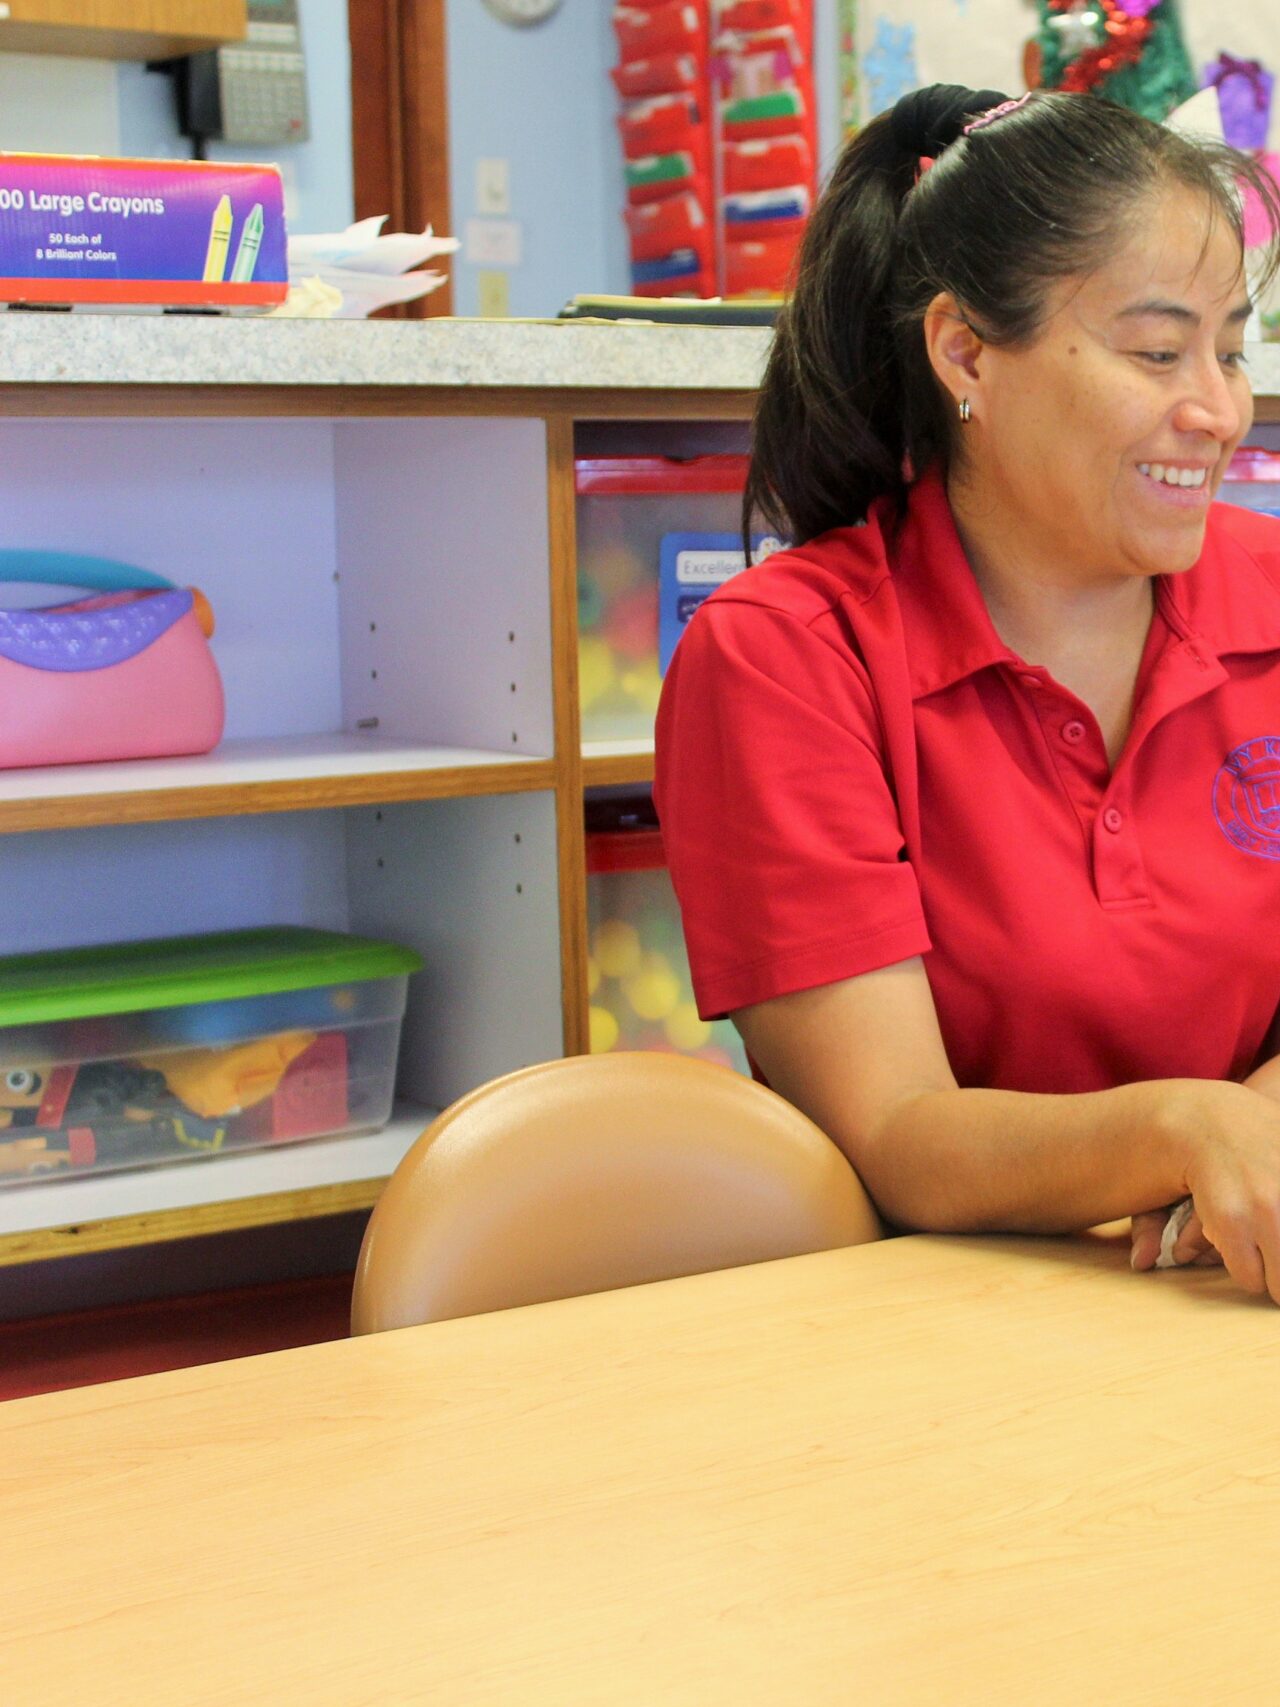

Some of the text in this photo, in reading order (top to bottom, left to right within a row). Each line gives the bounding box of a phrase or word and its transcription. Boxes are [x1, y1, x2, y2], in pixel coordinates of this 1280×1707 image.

[29, 190, 85, 217] Large
[88, 191, 165, 218] Crayons
[49, 233, 102, 245] 50 Each of
[46, 248, 84, 261] Brilliant
[86, 249, 117, 262] Colors
